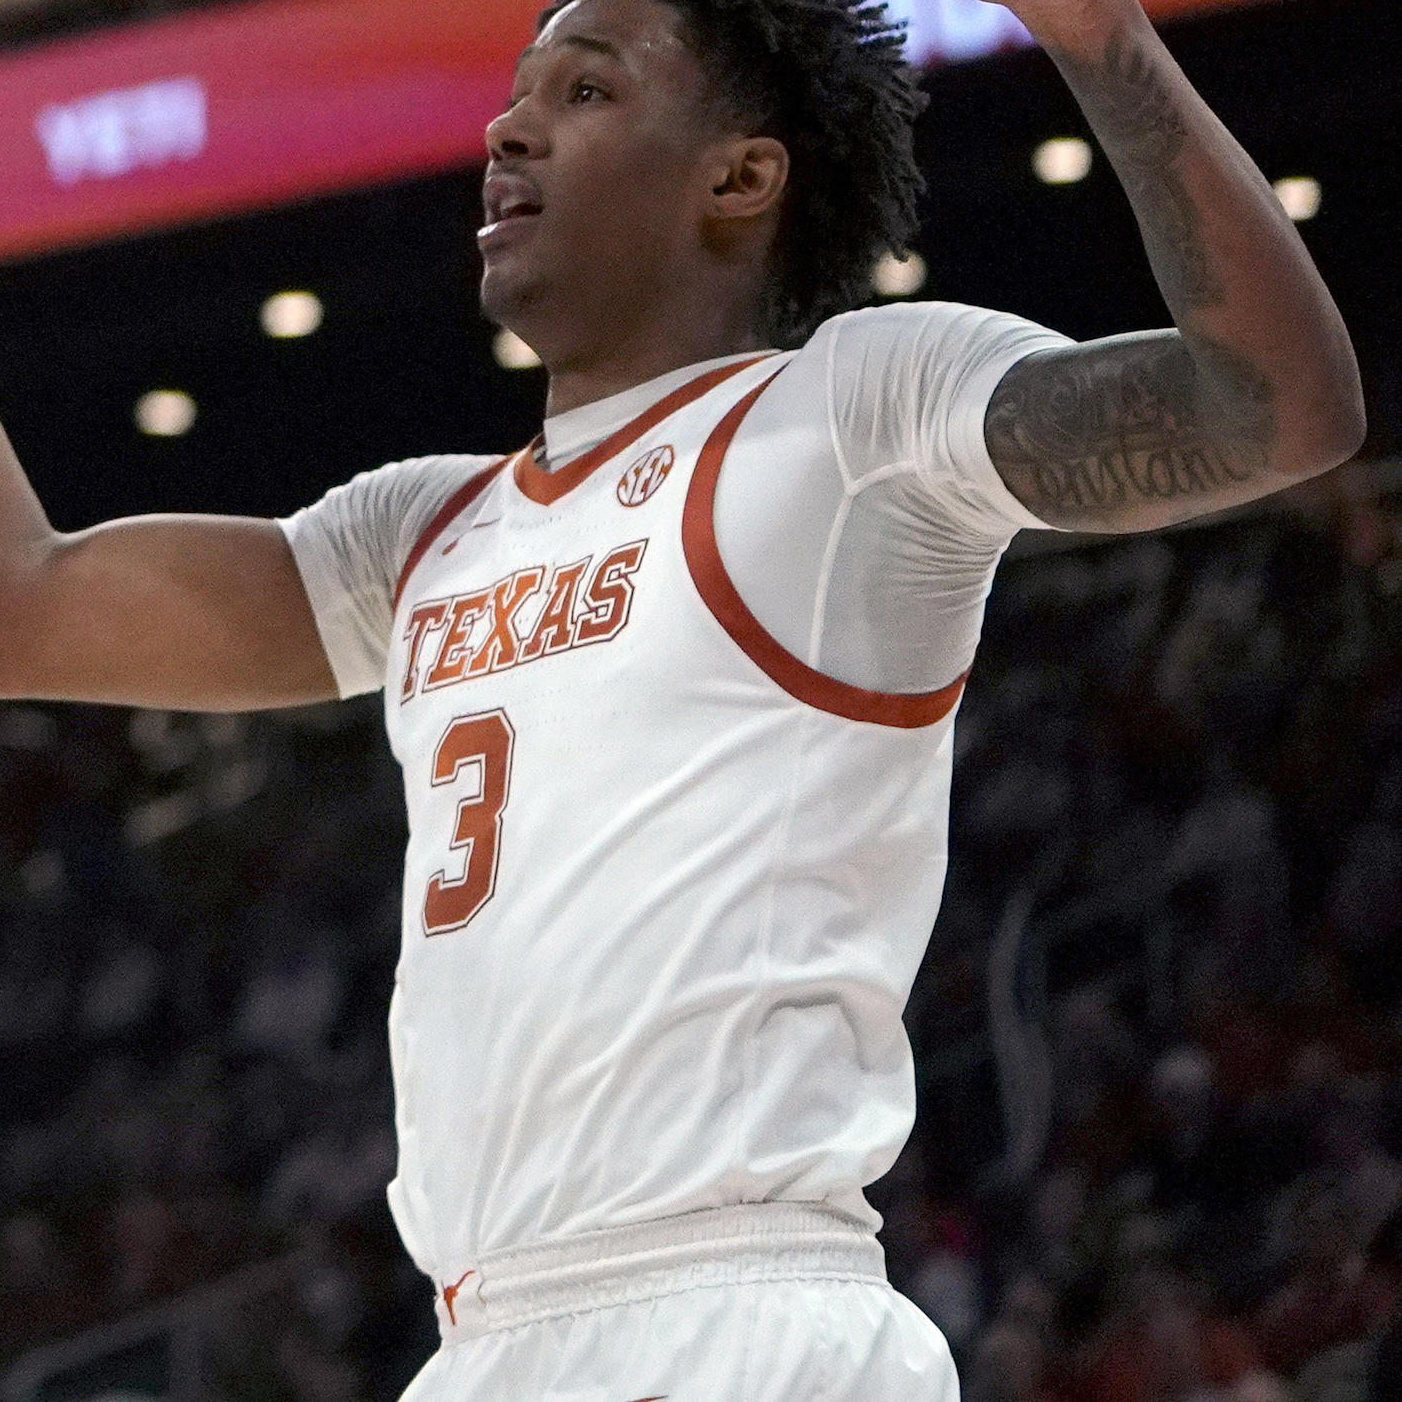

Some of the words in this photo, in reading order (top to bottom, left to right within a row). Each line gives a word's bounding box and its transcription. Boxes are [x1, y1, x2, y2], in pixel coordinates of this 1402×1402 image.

[37, 77, 208, 184] YETI
[618, 447, 673, 506] SEC
[400, 538, 649, 705] TEXAS
[422, 707, 516, 938] 3
